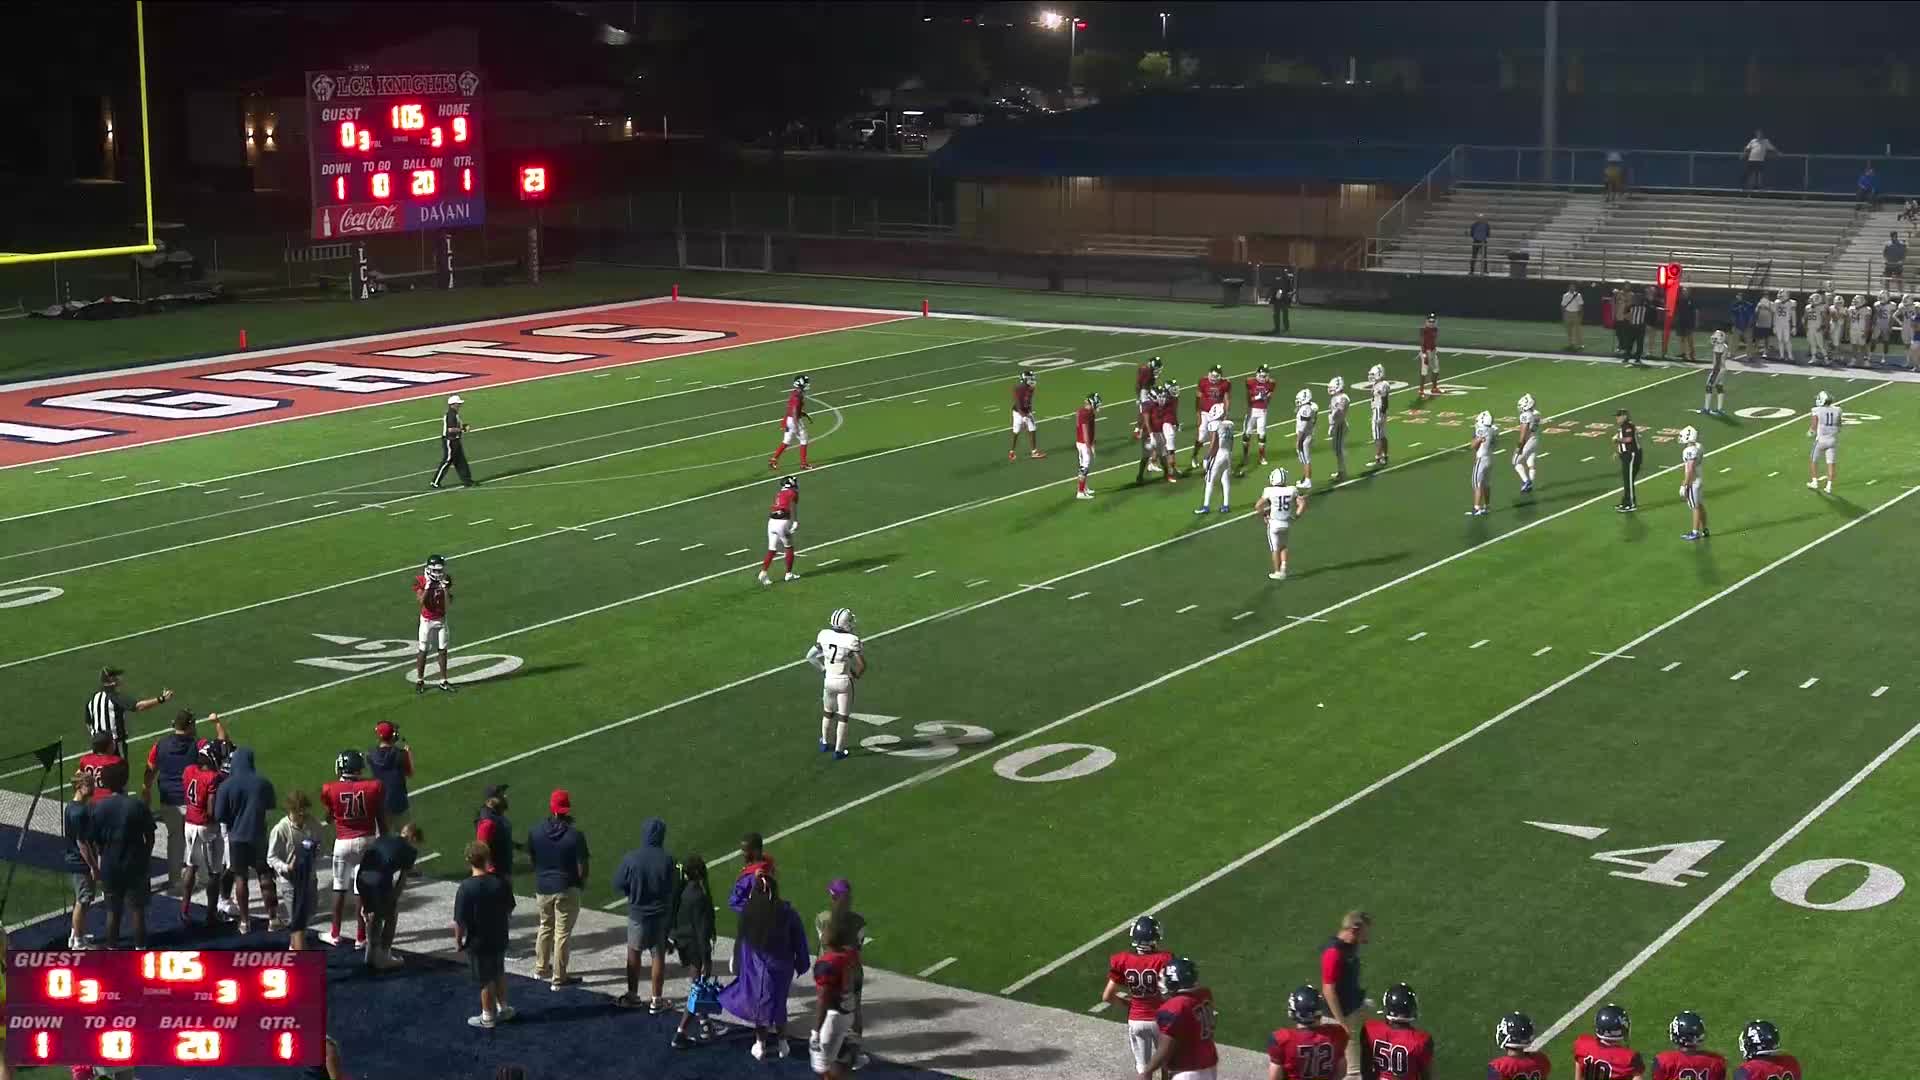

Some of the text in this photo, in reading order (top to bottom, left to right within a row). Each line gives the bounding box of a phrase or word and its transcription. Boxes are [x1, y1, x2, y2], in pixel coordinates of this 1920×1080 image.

[336, 74, 457, 97] LCA KNIGHTS
[322, 107, 361, 122] GUEST
[438, 103, 470, 117] HOME
[341, 122, 355, 147] 0
[358, 130, 370, 151] 3
[431, 127, 443, 147] 3
[453, 117, 467, 142] 9
[322, 162, 351, 176] DOWN
[362, 160, 391, 173] TO GO
[403, 157, 443, 170] BALL ON
[337, 176, 345, 200] 1
[411, 170, 435, 196] 20
[464, 168, 471, 191] 1
[421, 202, 470, 224] DASANI
[1825, 412, 1834, 427] 11
[1278, 496, 1291, 511] 15
[828, 643, 838, 664] 7
[187, 779, 198, 806] 4
[339, 789, 368, 820] 71
[1590, 839, 1906, 911] 40
[1296, 1042, 1334, 1079] 72
[1373, 1039, 1408, 1078] 50
